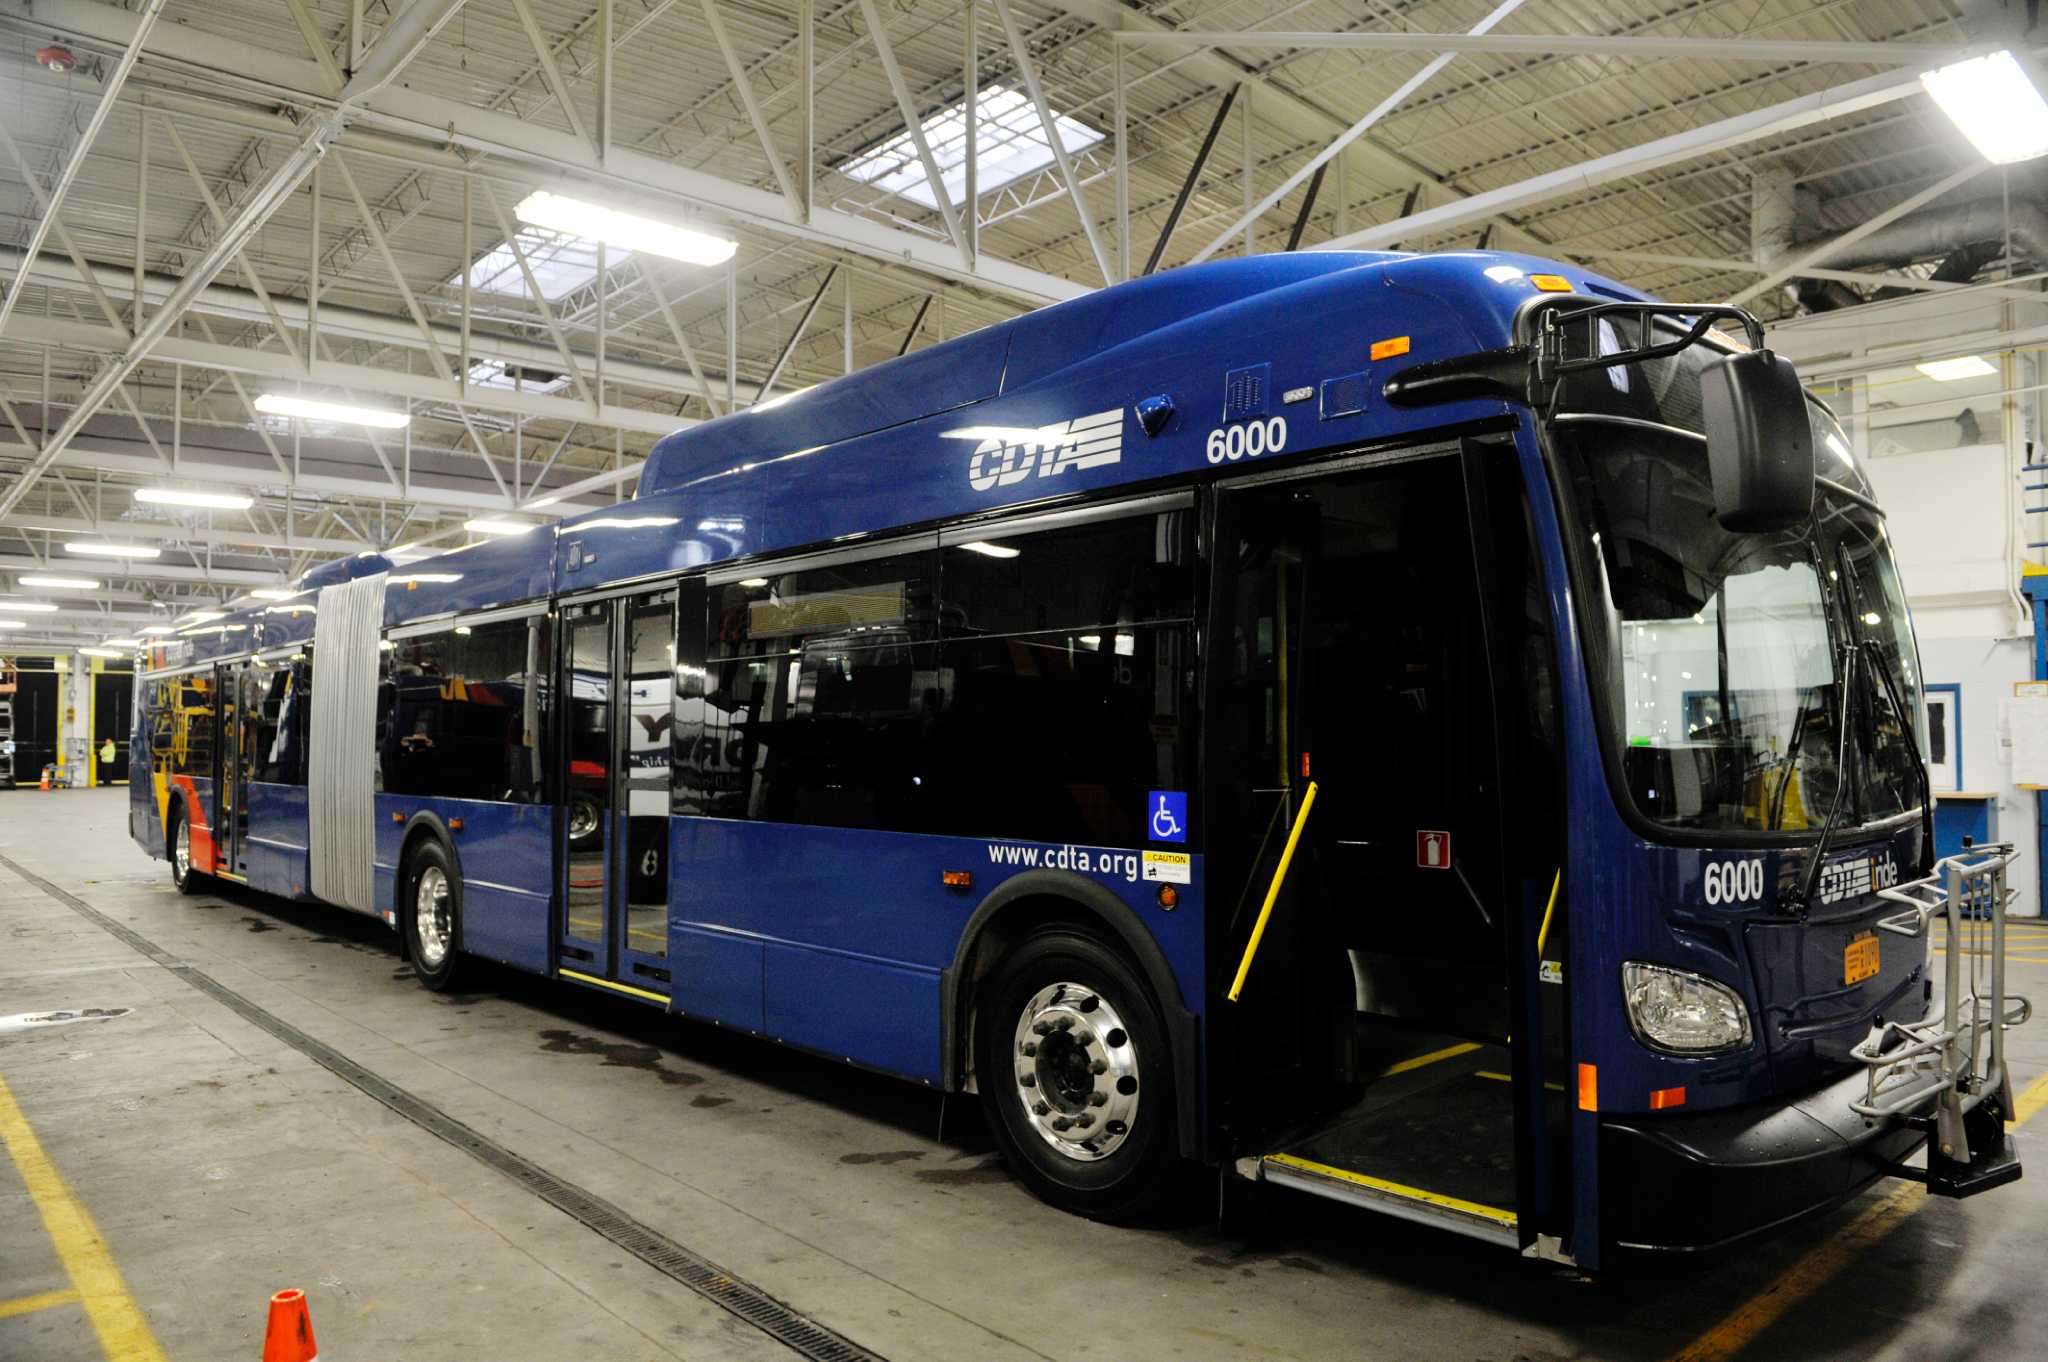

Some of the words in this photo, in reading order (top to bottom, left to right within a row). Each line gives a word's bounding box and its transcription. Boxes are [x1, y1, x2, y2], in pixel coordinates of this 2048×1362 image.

[969, 408, 1124, 491] CDTA
[1206, 416, 1287, 464] 6000
[988, 844, 1138, 882] www.cdta.org
[1152, 854, 1187, 864] CAUTION
[1704, 858, 1764, 905] 6000
[1819, 857, 1871, 905] CDTA
